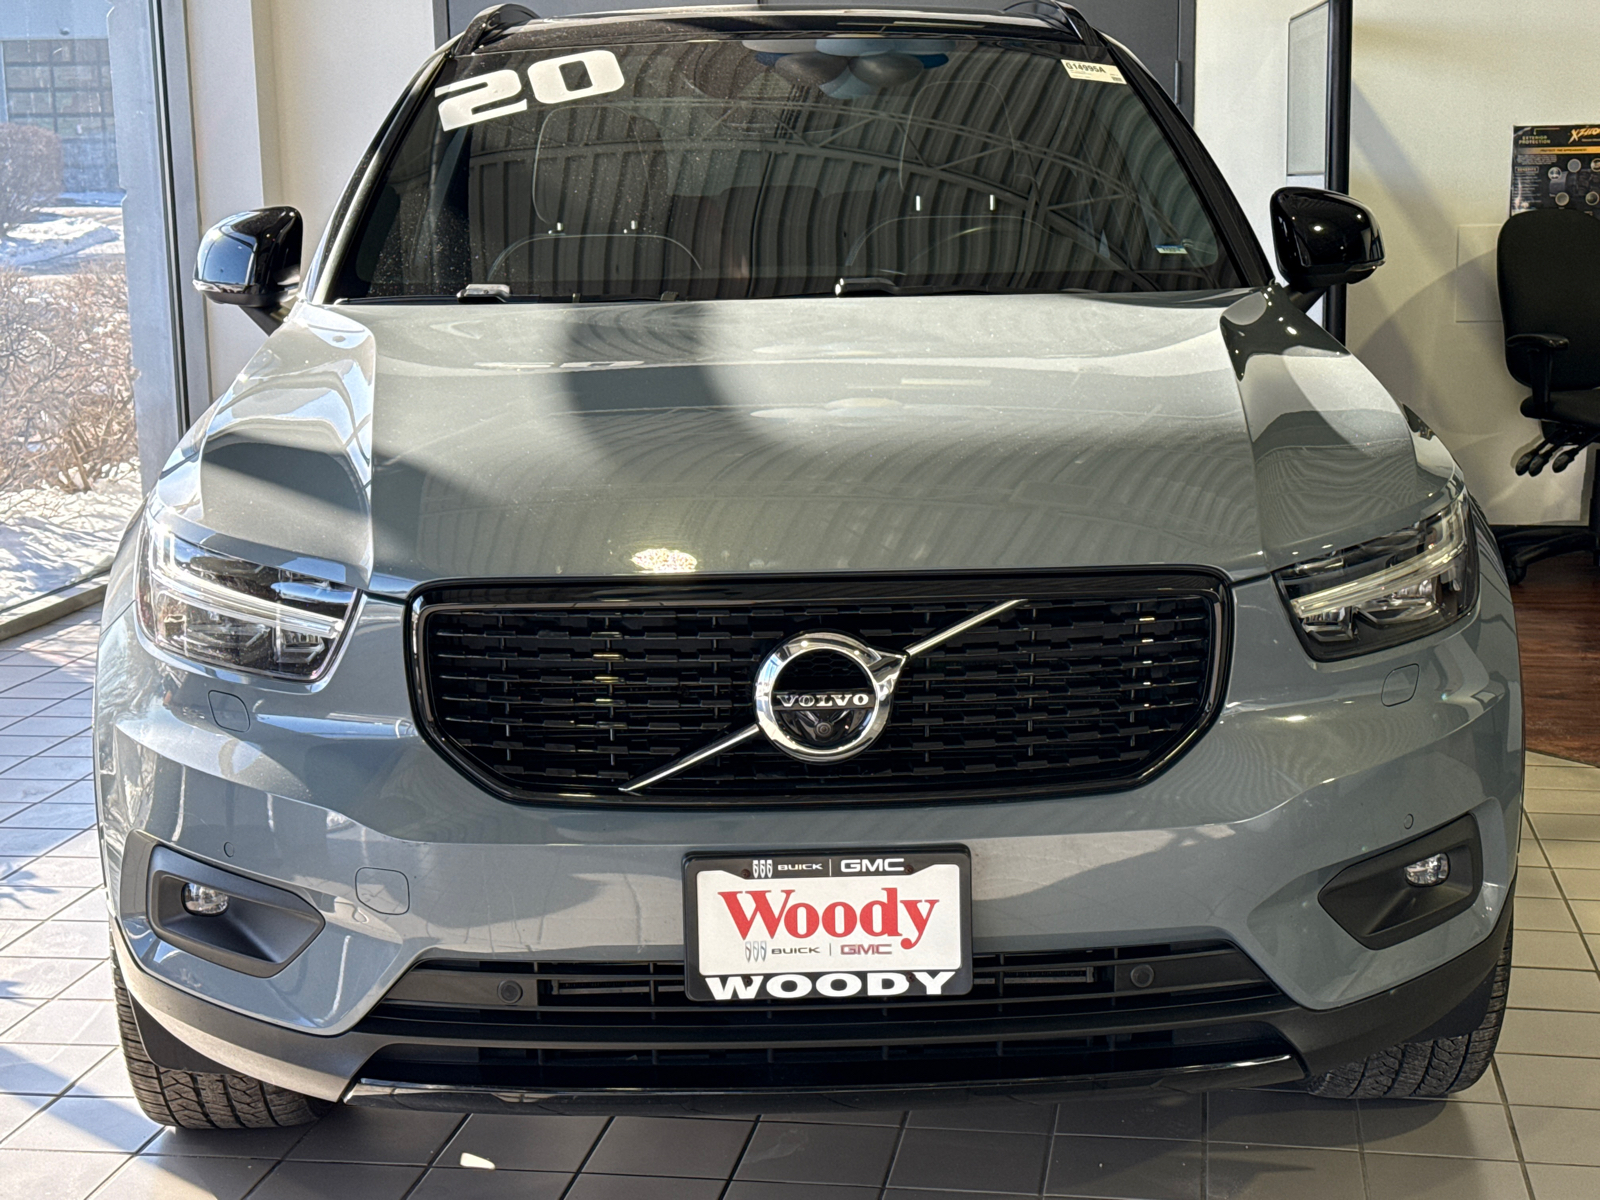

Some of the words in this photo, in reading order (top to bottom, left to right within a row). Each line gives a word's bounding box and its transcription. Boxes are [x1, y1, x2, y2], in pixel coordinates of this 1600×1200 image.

[434, 50, 625, 132] 20
[776, 693, 869, 707] VOLVO
[777, 862, 823, 871] BUICK
[840, 858, 905, 872] GMC
[717, 887, 940, 950] Woody
[771, 946, 820, 955] BUICK
[840, 943, 892, 955] GMC
[705, 971, 956, 1000] WOODY
